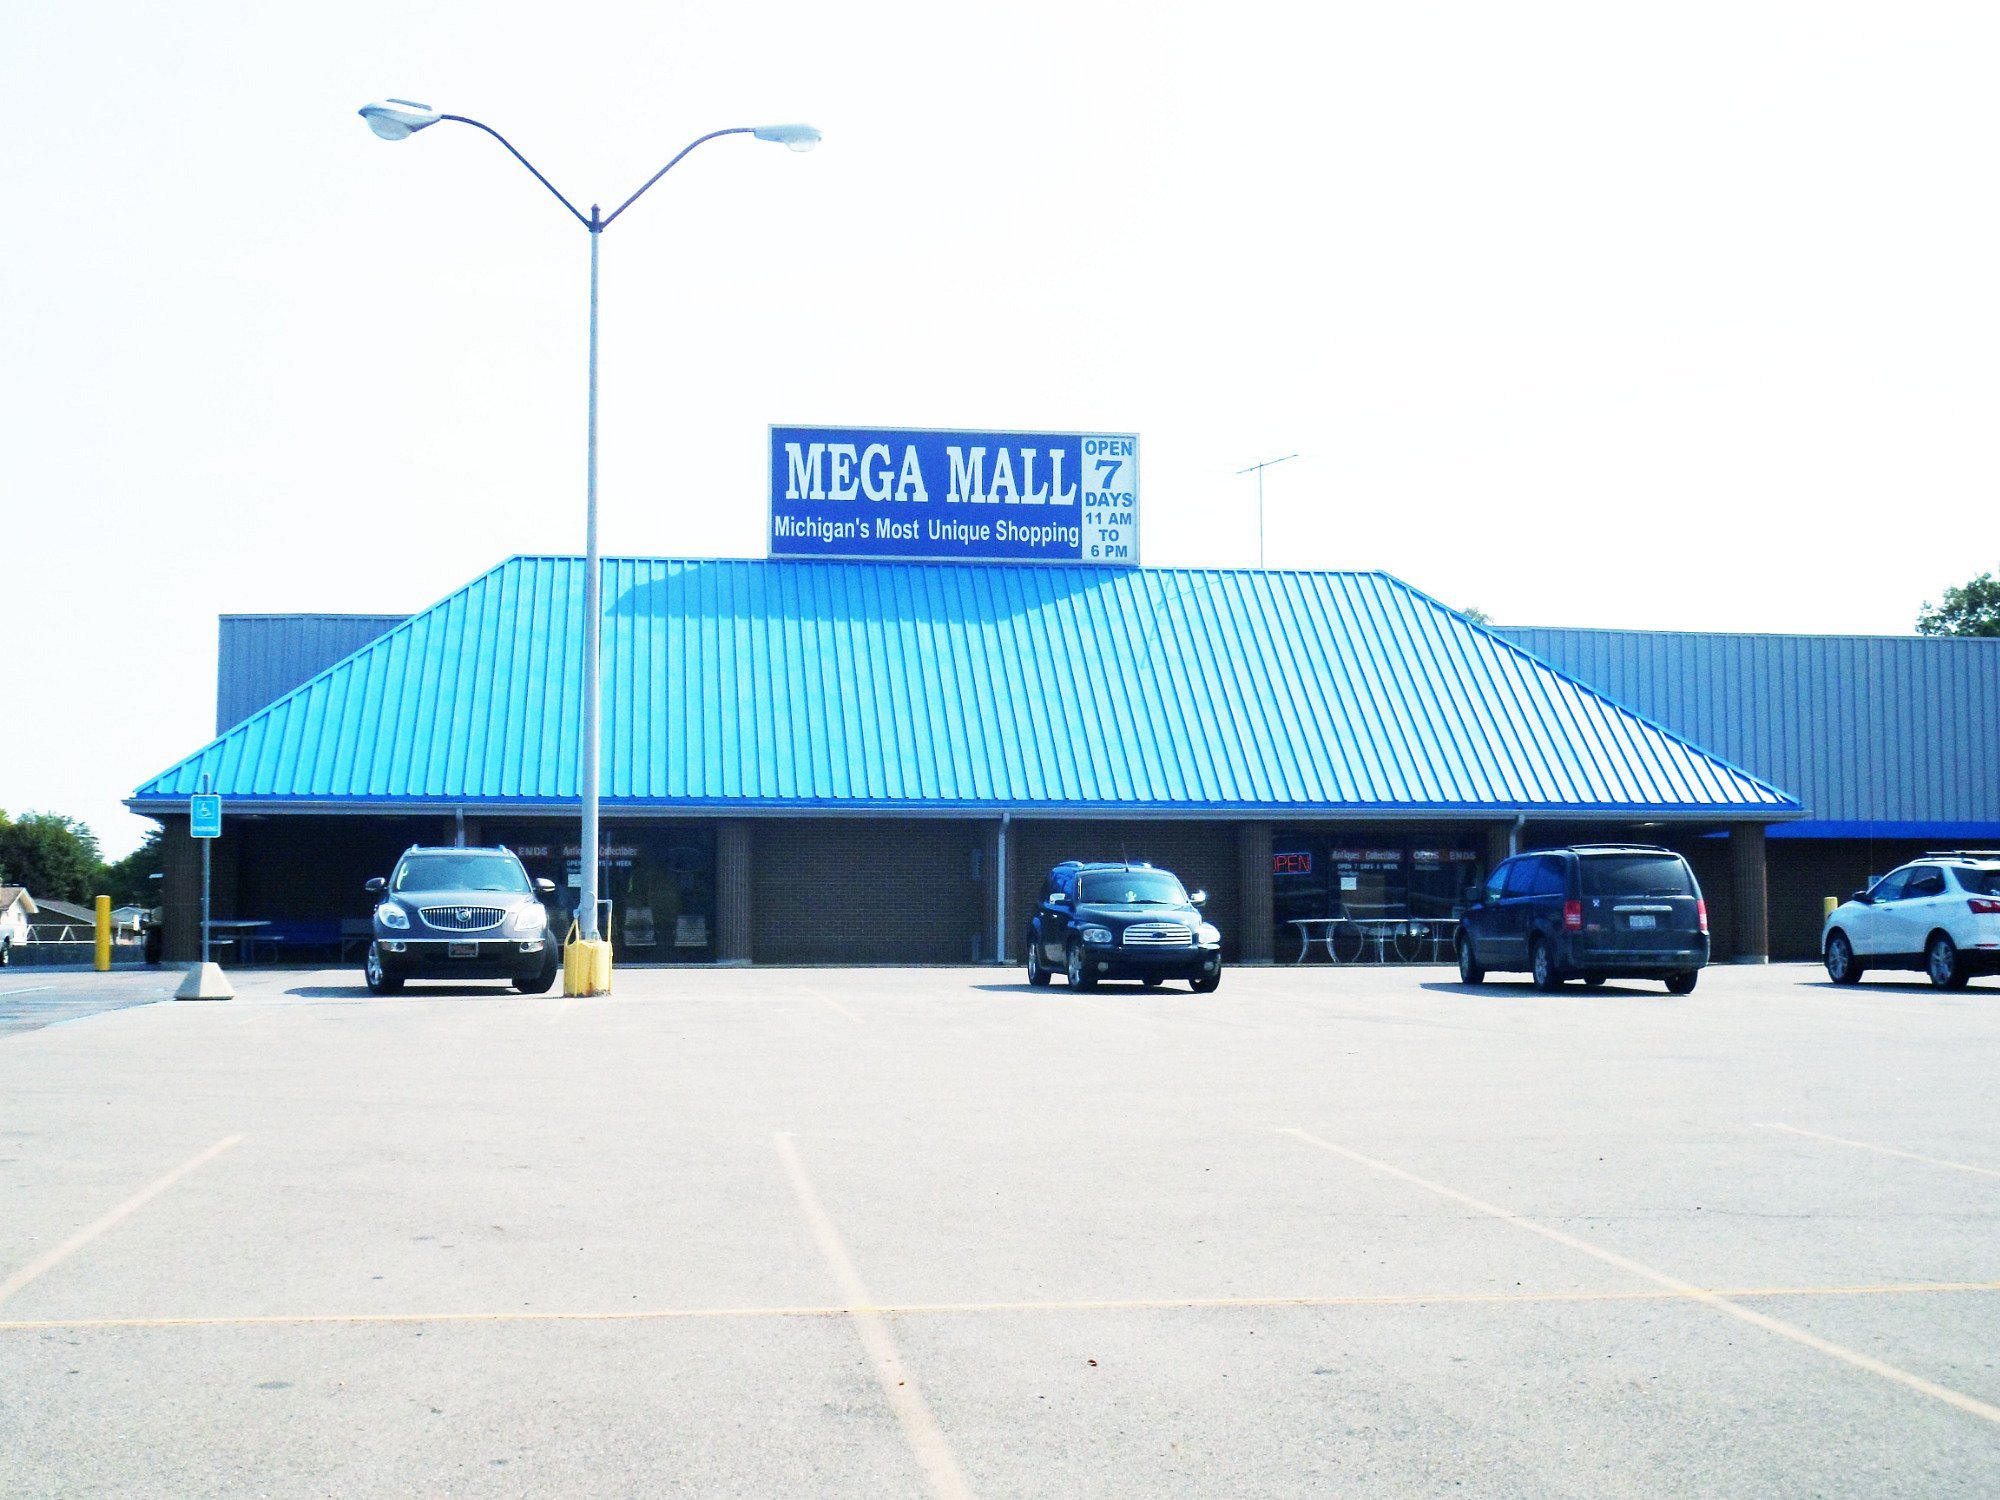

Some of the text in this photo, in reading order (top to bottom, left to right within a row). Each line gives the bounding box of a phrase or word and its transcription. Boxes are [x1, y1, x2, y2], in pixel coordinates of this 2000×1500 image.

[1084, 440, 1133, 456] OPEN
[785, 442, 1078, 505] MEGA MALL
[1094, 459, 1123, 489] 7
[1085, 492, 1133, 508] DAYS
[1085, 513, 1132, 525] 11 AM
[774, 515, 1079, 547] Michigan's Most Unique Shopping
[1098, 529, 1120, 542] TO
[1090, 545, 1128, 558] 6 PM
